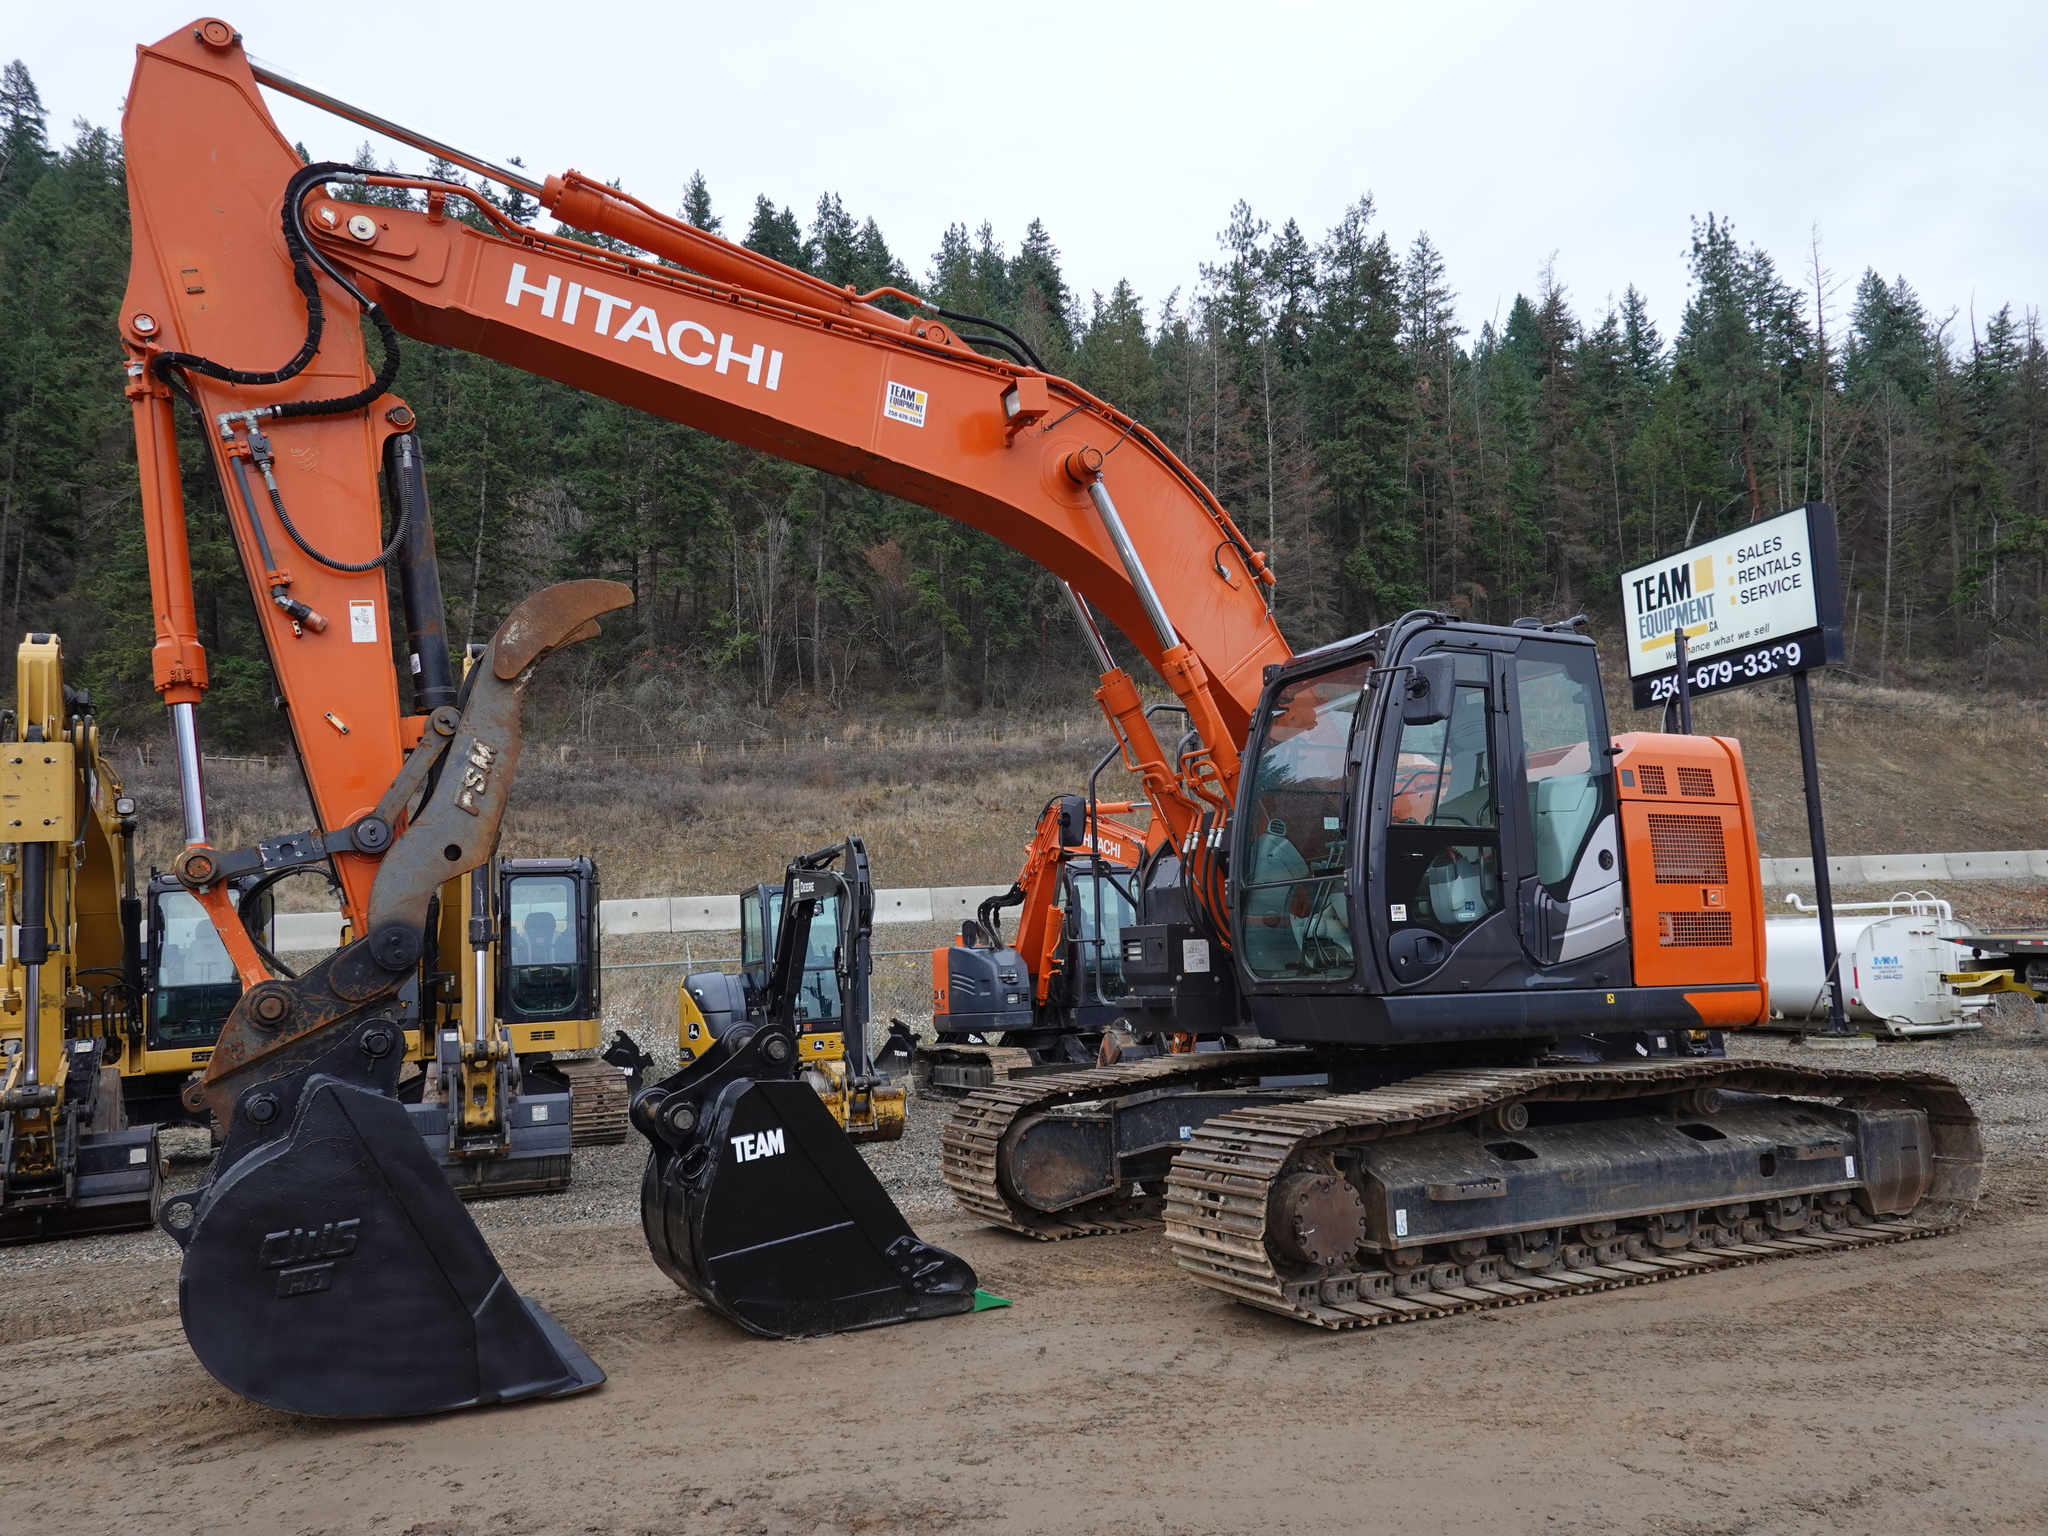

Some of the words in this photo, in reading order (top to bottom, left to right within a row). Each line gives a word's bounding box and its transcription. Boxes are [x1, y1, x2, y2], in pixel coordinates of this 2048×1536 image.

[505, 262, 783, 391] HITACHI
[889, 396, 923, 413] EQUIPMENT
[890, 384, 916, 402] TEAM
[1737, 536, 1782, 564] SALES
[1738, 551, 1801, 585] RENTALS
[1633, 563, 1692, 615] TEAM
[1740, 573, 1802, 604] SERVICE
[1638, 593, 1715, 640] EQUIPMENT
[1708, 620, 1719, 632] .CA
[1665, 651, 1677, 661] We
[1714, 633, 1734, 647] what
[1738, 630, 1750, 640] we
[1754, 623, 1770, 636] sell
[1083, 832, 1121, 858] HIACHI
[800, 881, 815, 893] DEERE
[730, 1127, 785, 1163] TEAM
